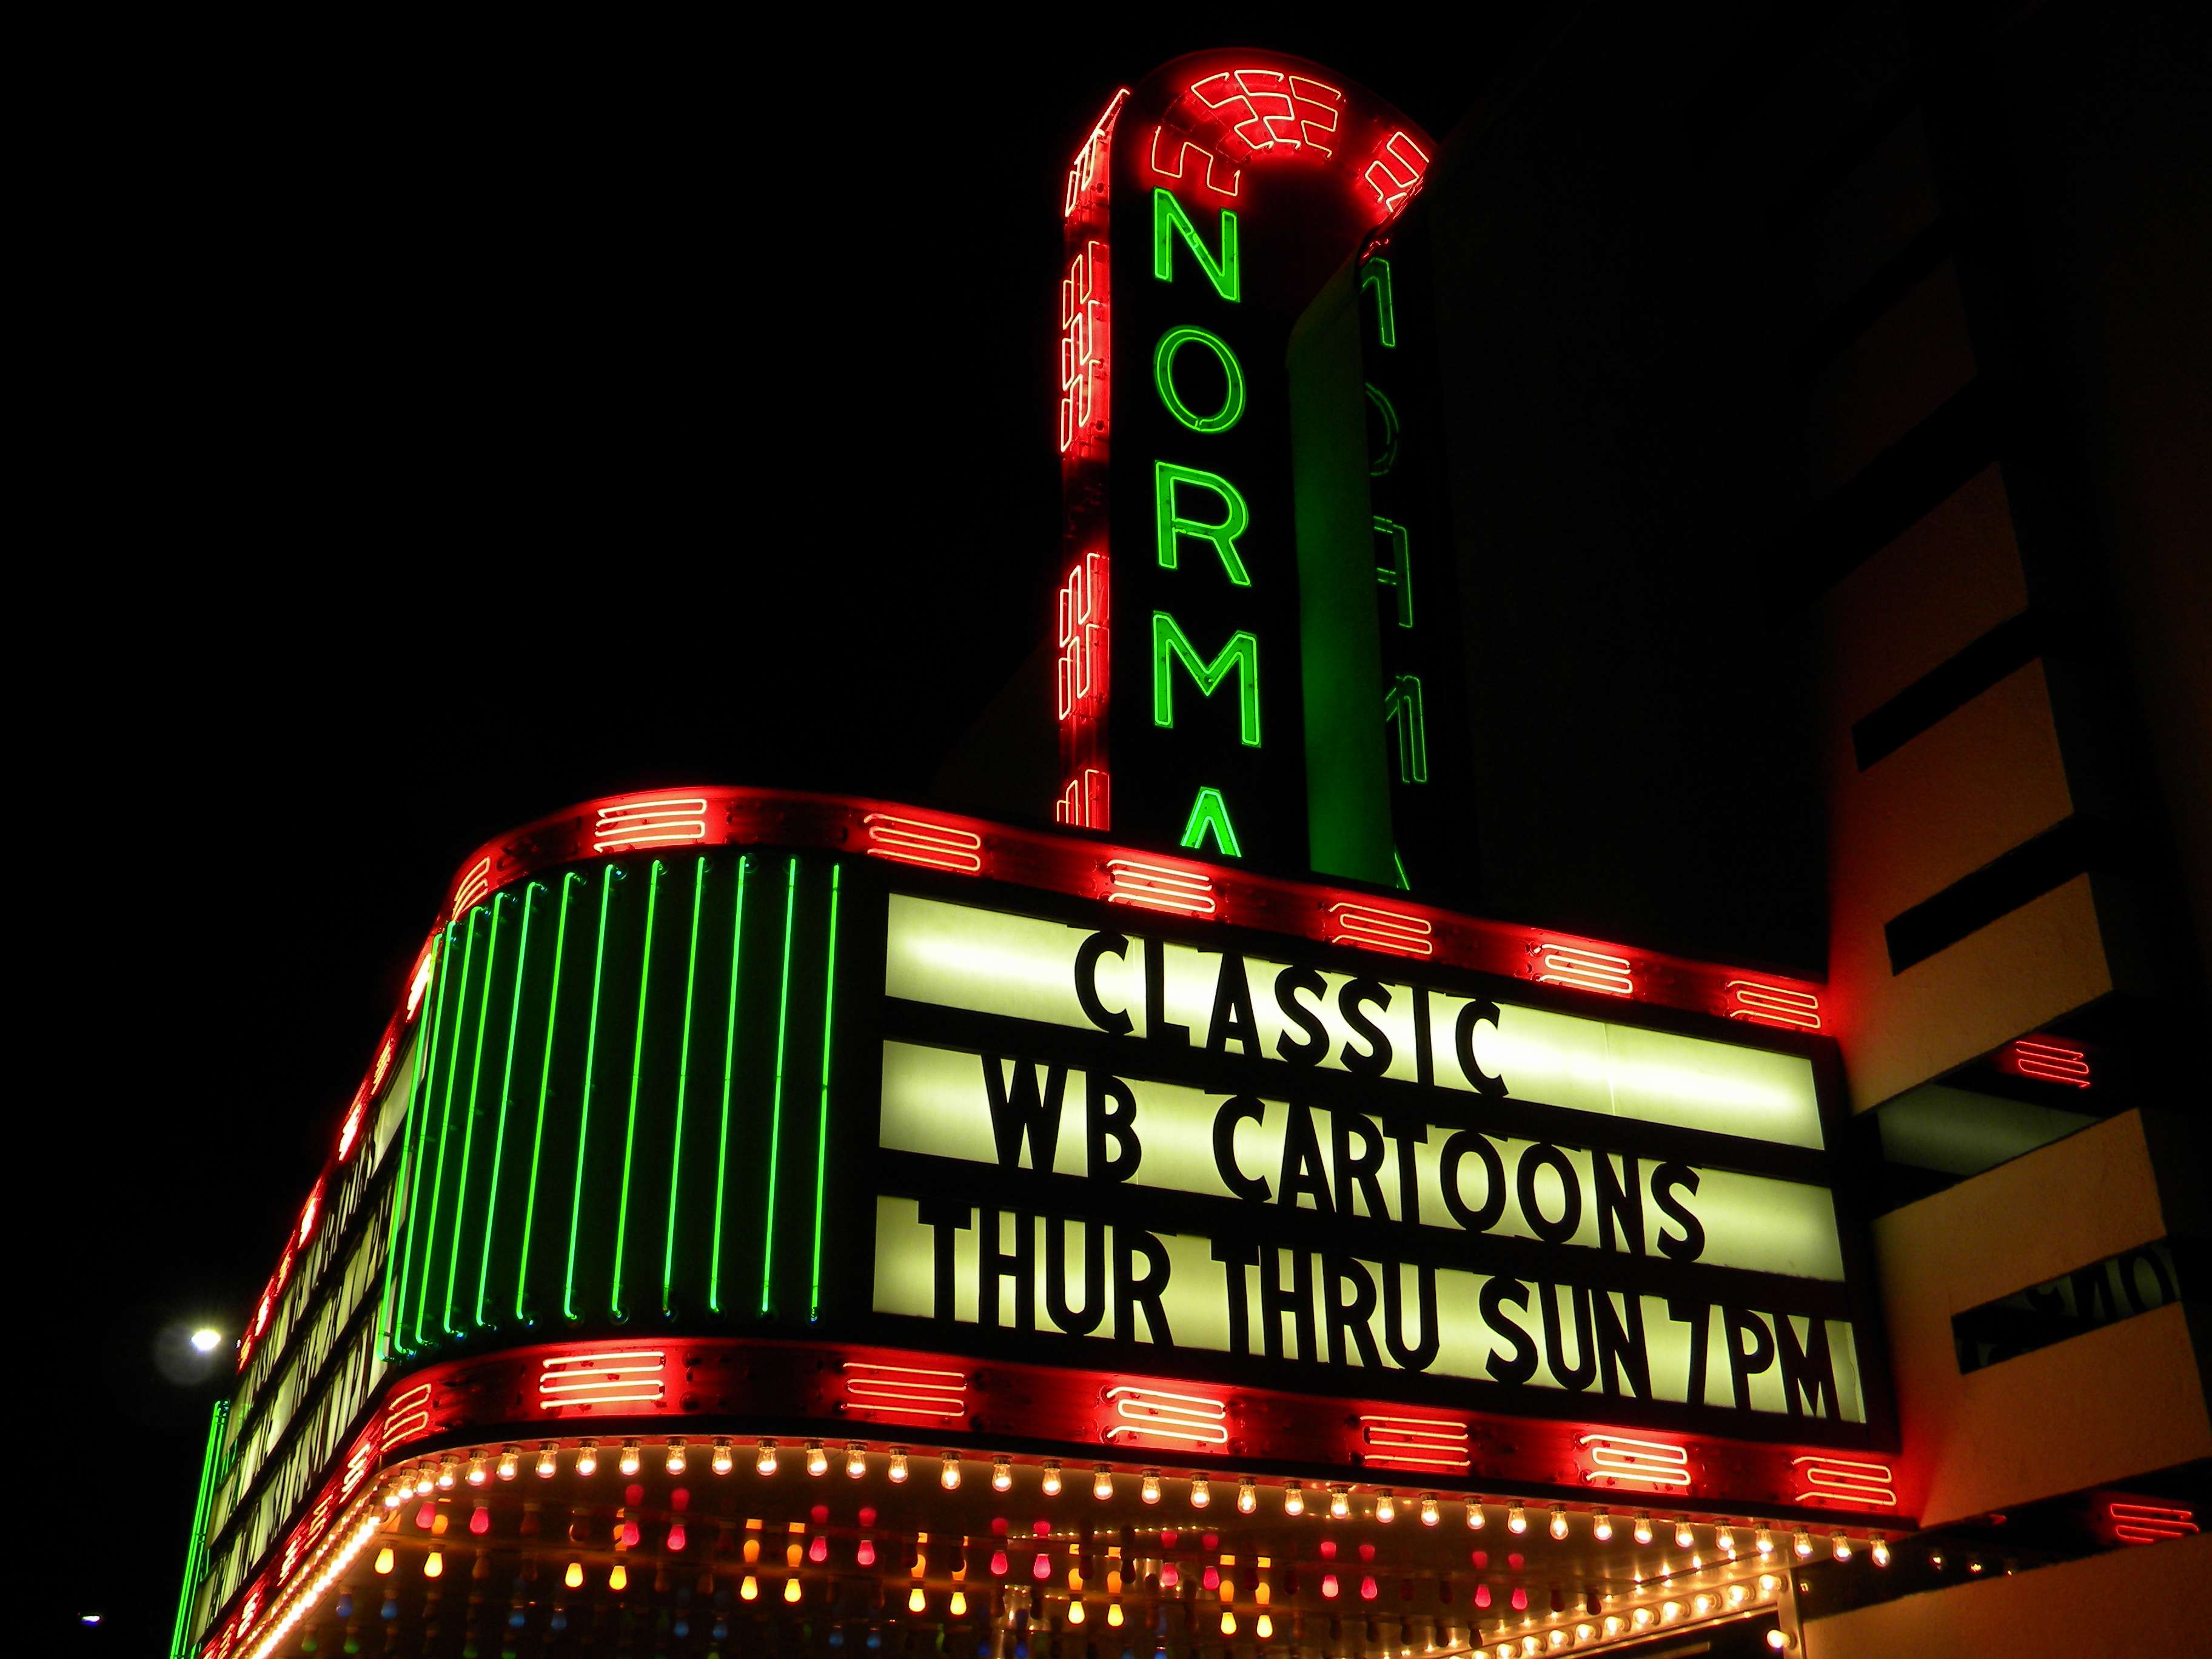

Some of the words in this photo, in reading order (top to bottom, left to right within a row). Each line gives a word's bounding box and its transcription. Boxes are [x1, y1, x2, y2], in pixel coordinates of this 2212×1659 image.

[1074, 931, 1509, 1098] CLASSIC
[980, 1052, 1142, 1183] WB
[1213, 1094, 1706, 1263] CARTOONS
[917, 1201, 1175, 1347] THUR
[1210, 1235, 1440, 1372] THRU
[1479, 1275, 1653, 1401] SUN
